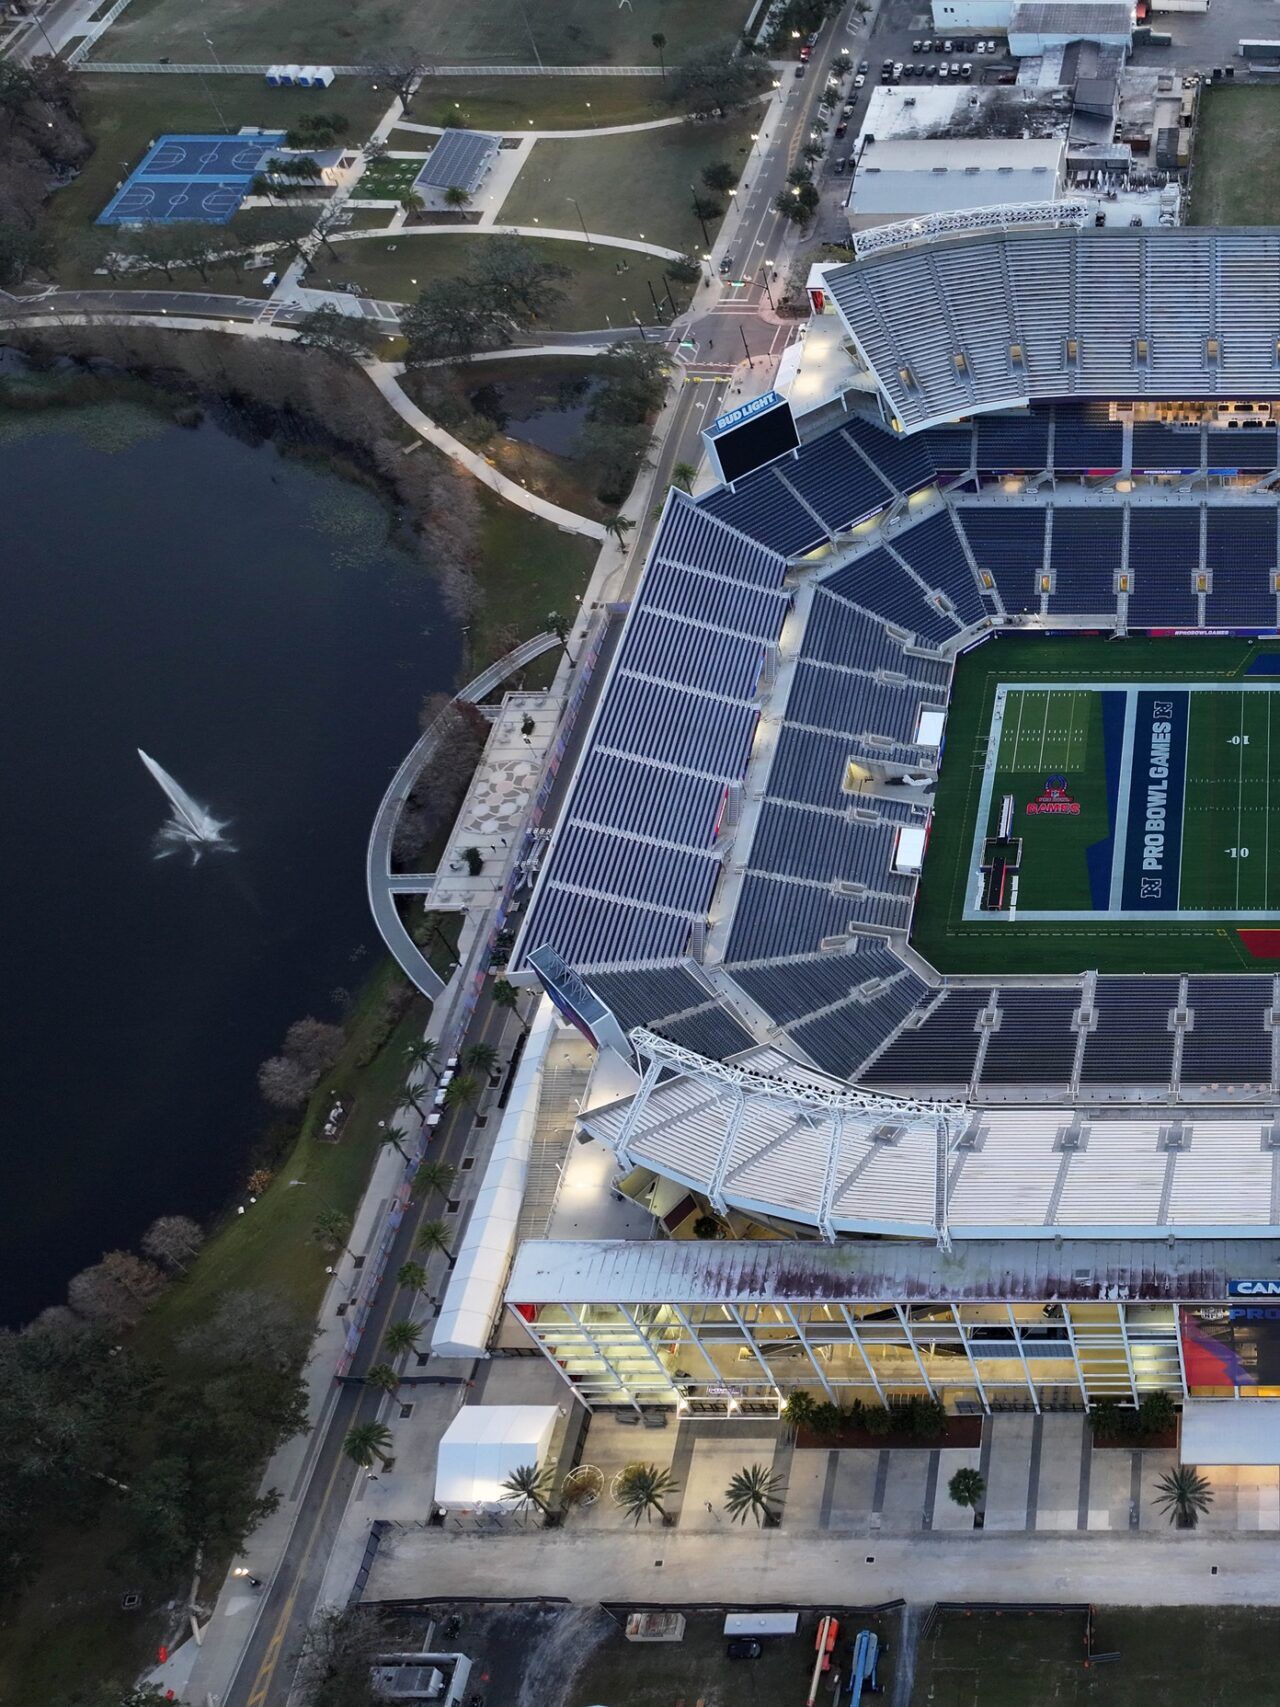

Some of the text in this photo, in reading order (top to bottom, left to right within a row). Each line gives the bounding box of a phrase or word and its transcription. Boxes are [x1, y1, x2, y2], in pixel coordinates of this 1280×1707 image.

[717, 393, 775, 429] BUD LIGHT
[1149, 721, 1172, 779] GAMES
[1026, 803, 1081, 815] GAMES
[1145, 779, 1168, 832] BOWL
[1142, 833, 1165, 871] PRO
[1230, 848, 1250, 858] 10
